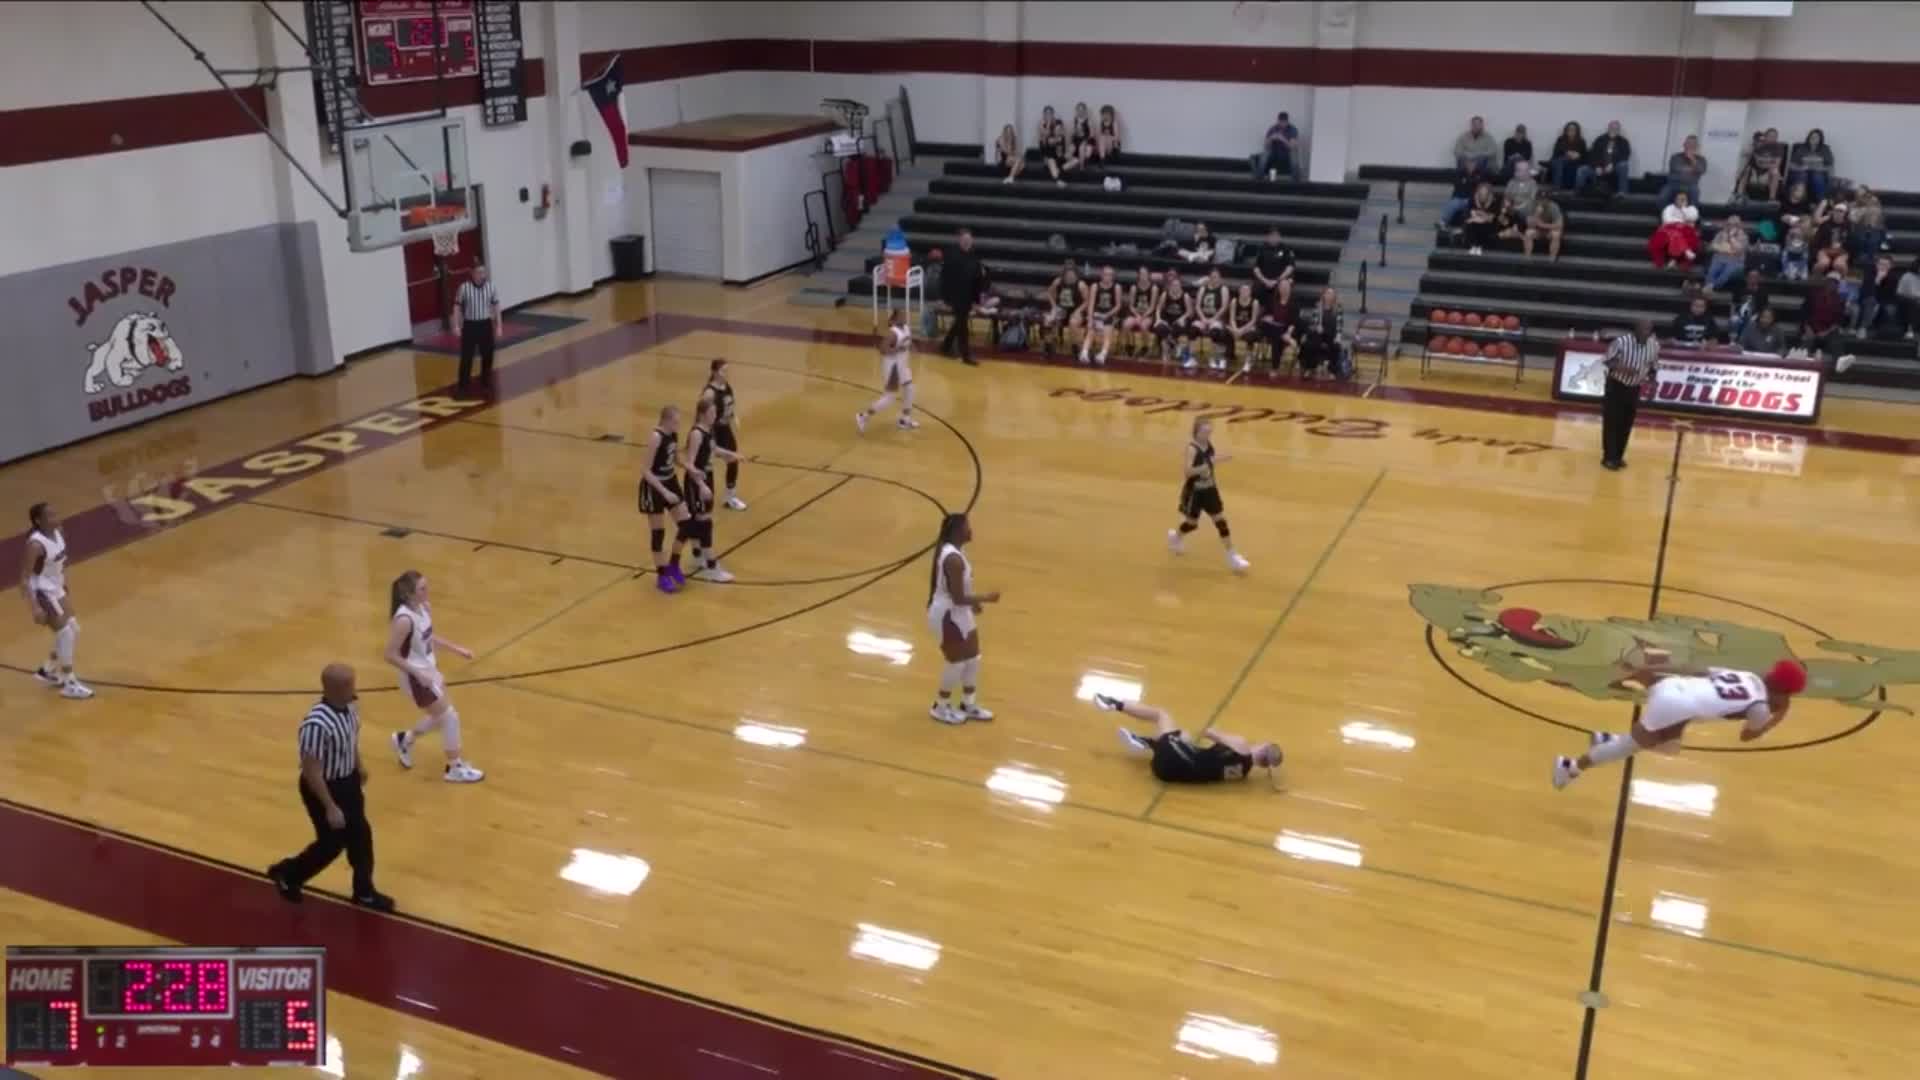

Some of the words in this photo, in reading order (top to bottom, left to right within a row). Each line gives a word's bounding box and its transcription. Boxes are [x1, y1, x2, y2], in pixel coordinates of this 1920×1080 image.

[68, 266, 176, 327] JASPER
[1687, 374, 1719, 385] Home
[1721, 377, 1733, 386] of
[1743, 369, 1770, 381] High
[1773, 372, 1811, 384] School
[88, 375, 193, 422] BULLDOGS
[129, 396, 486, 521] JASPER
[1711, 673, 1750, 700] 23
